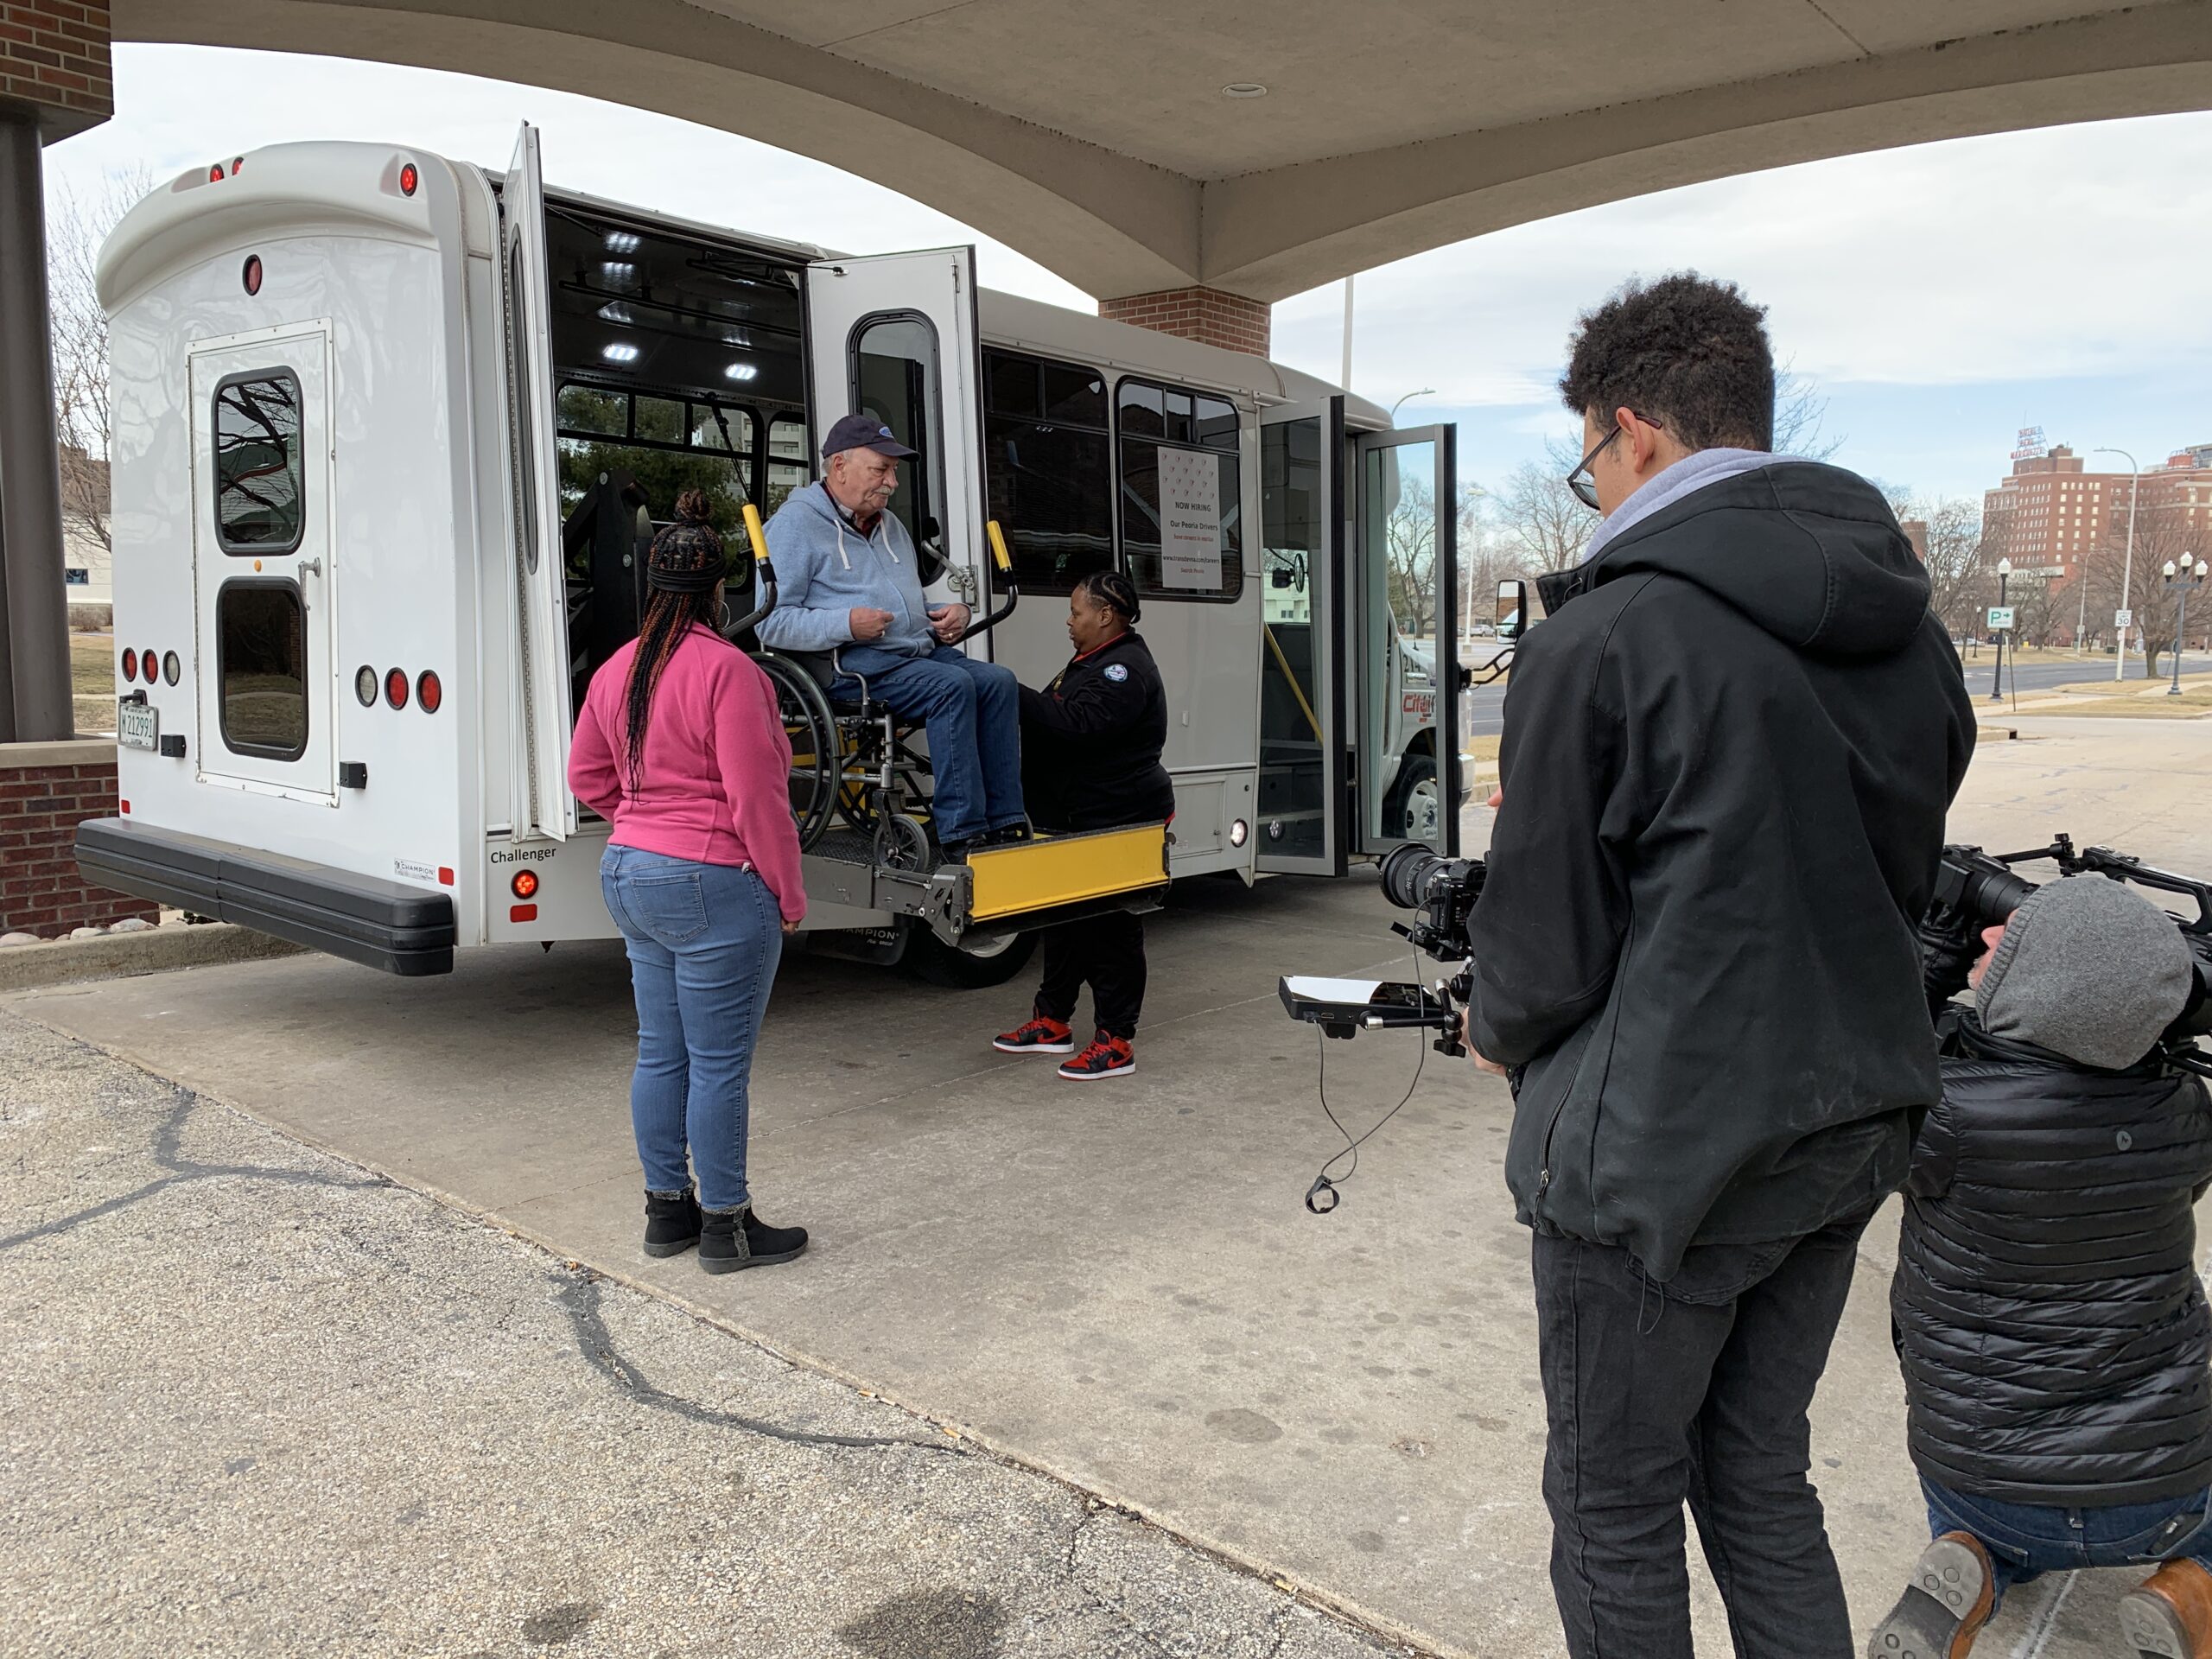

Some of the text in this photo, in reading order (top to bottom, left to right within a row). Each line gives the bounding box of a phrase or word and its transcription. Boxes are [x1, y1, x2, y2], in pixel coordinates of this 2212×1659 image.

[1175, 501, 1211, 512] NOW HIRING
[1181, 521, 1198, 530] Peoria
[1199, 523, 1218, 531] Drivers
[1991, 611, 2001, 624] P
[128, 715, 152, 738] 212991
[490, 848, 556, 863] Challenger
[401, 863, 434, 875] CHAMPION
